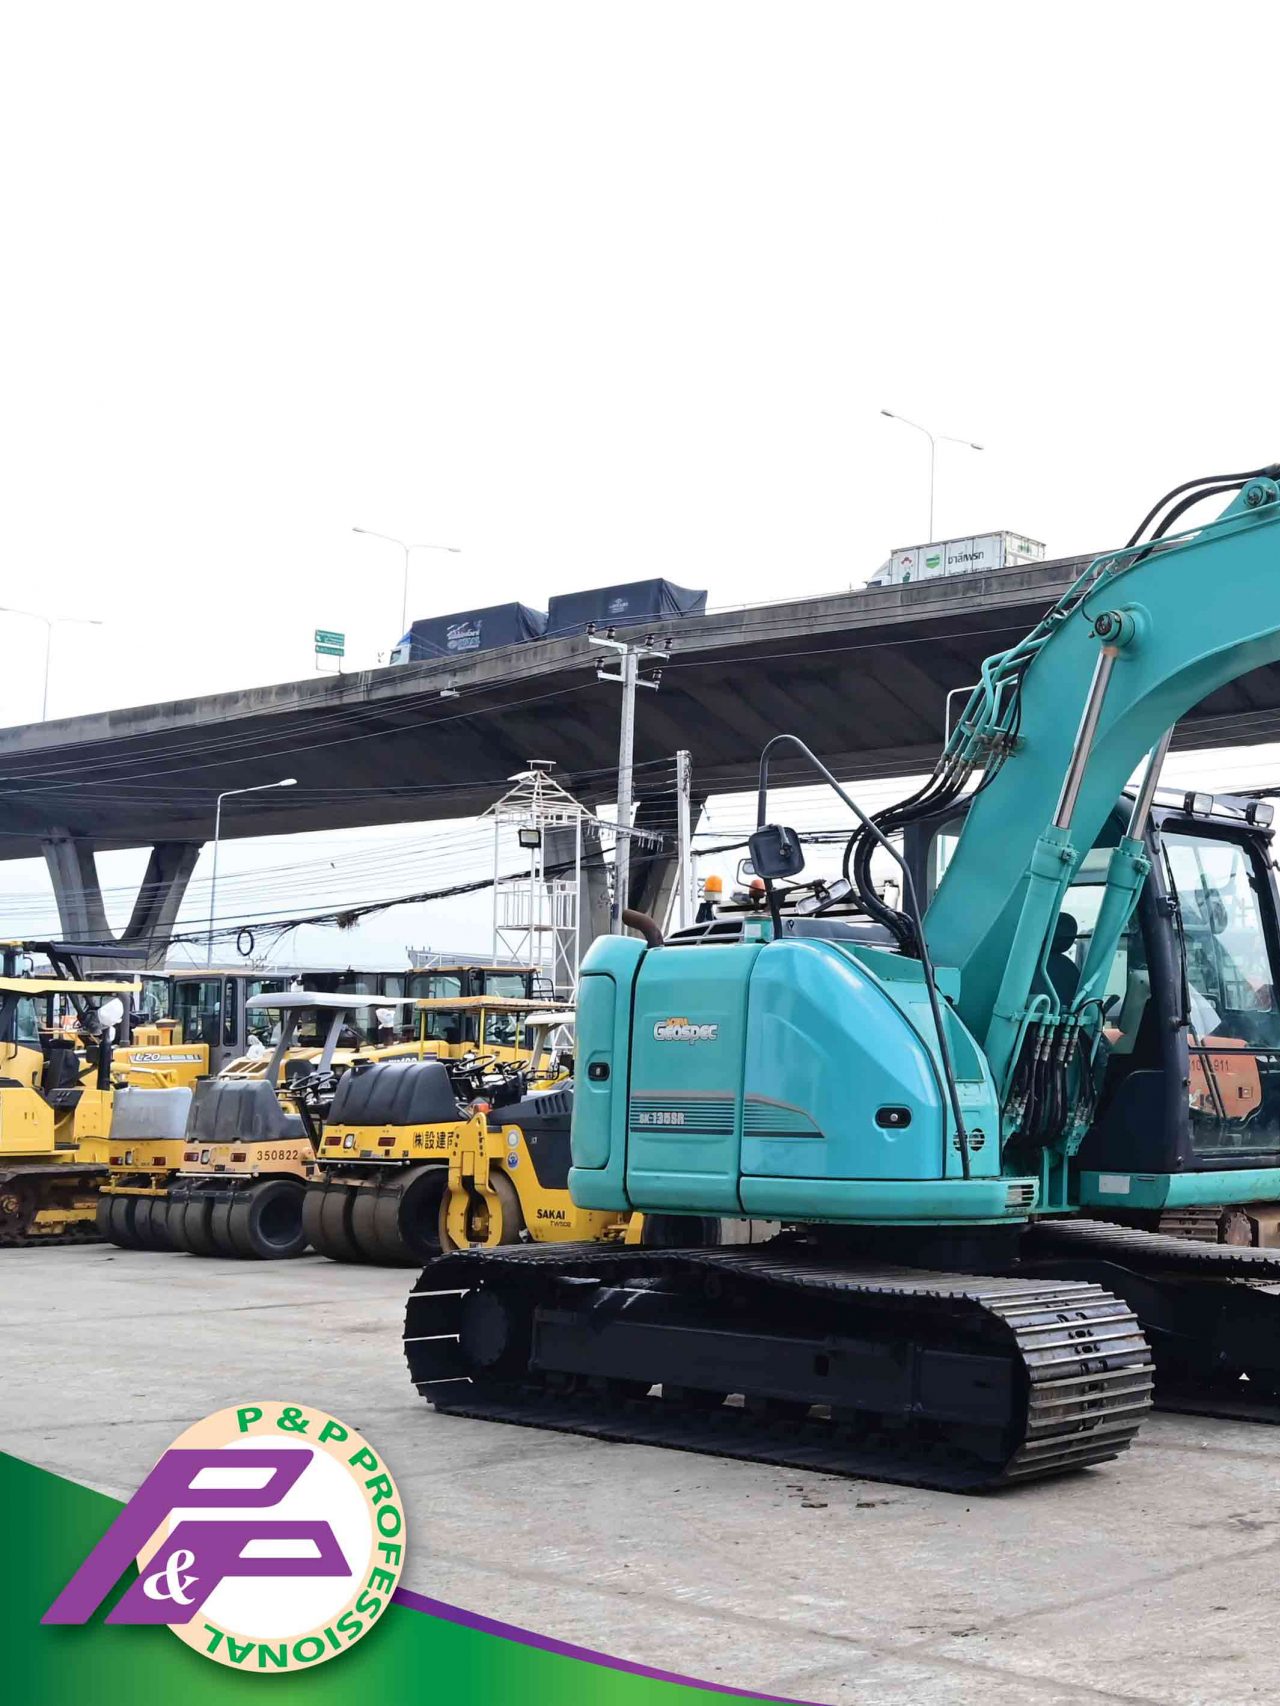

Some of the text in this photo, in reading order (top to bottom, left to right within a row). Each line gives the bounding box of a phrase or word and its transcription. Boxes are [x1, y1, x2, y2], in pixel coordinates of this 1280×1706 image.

[653, 1020, 718, 1045] Geospec
[257, 1150, 299, 1160] 350822
[537, 1209, 566, 1219] SAKAI
